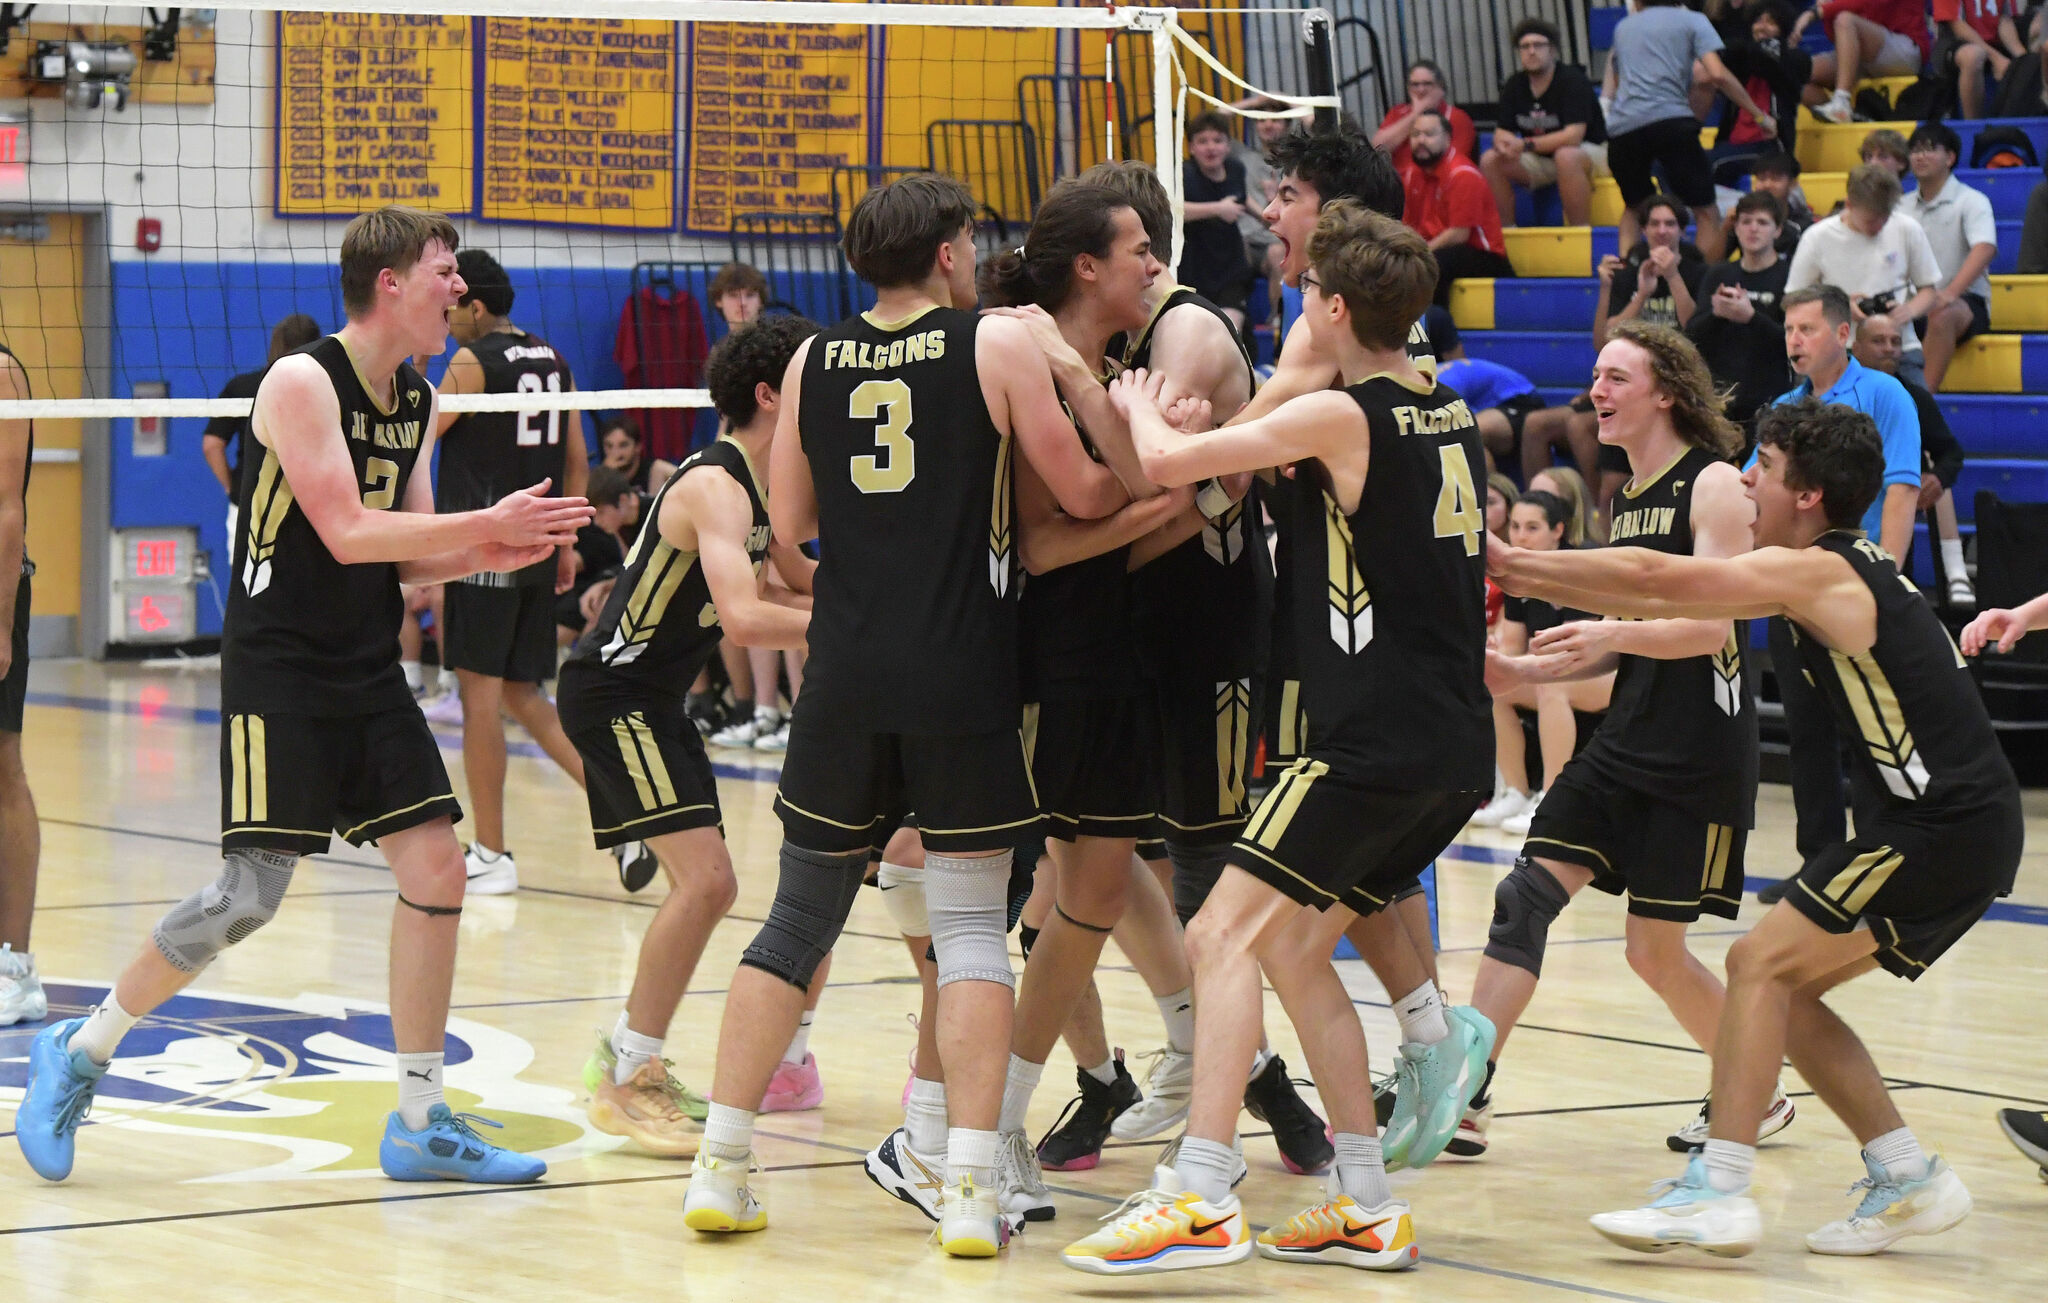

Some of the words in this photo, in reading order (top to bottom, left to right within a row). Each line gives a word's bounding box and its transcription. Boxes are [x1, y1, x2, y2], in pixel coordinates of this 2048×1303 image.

[824, 329, 946, 371] FALCONS
[516, 371, 561, 447] 21
[848, 377, 916, 495] 3
[363, 455, 400, 510] 2
[1432, 442, 1484, 557] 4
[135, 540, 177, 577] EXIT
